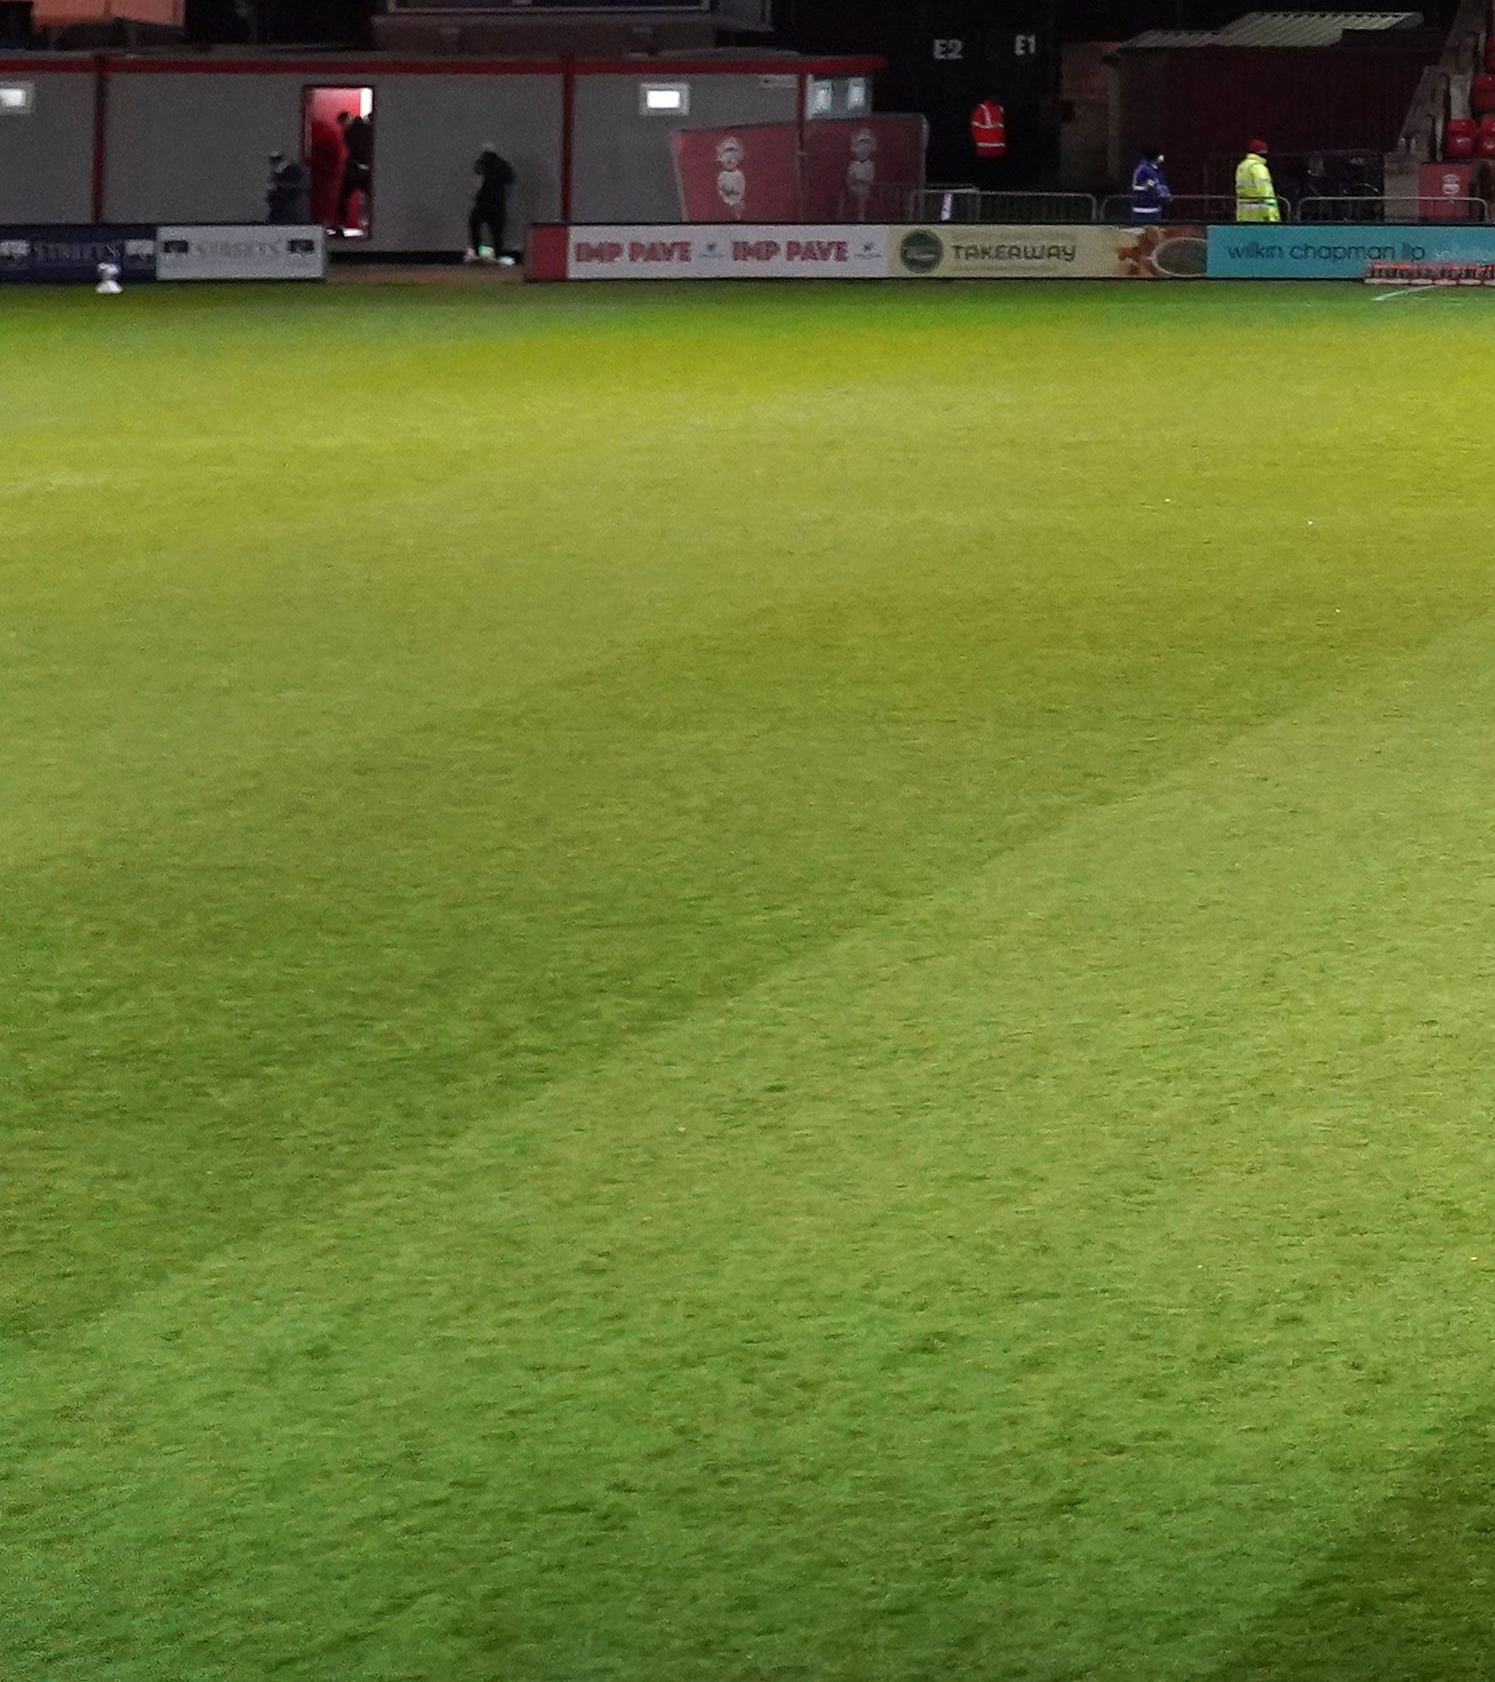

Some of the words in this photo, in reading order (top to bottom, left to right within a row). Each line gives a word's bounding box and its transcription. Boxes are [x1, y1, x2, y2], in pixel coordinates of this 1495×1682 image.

[933, 38, 964, 60] E2
[1014, 34, 1036, 56] E1
[628, 241, 692, 263] PAVE
[785, 240, 849, 262] PAVE
[1227, 240, 1283, 260] wilkin
[1289, 243, 1396, 265] chapman
